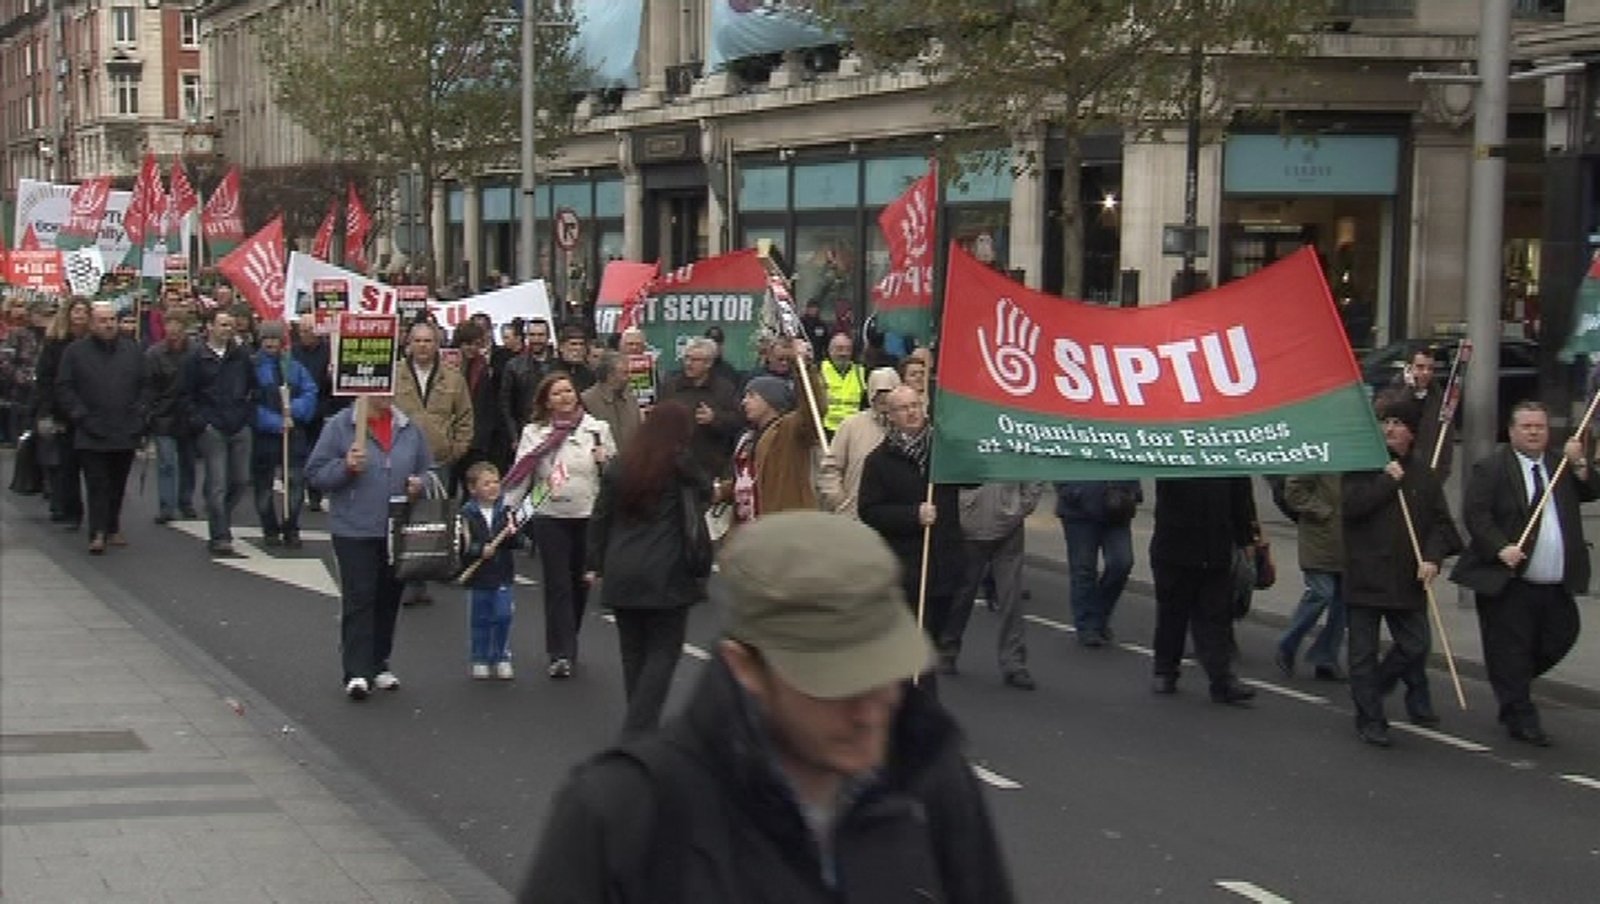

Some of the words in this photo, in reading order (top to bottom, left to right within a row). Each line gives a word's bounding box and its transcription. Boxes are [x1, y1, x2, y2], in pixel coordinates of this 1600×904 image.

[664, 296, 753, 321] SECTOR
[1054, 324, 1257, 406] SIPTU
[998, 414, 1131, 449] Organising
[1137, 429, 1174, 446] for
[1180, 422, 1290, 447] Fairness
[977, 437, 1002, 453] at
[1201, 449, 1228, 465] in
[1235, 442, 1329, 465] Society
